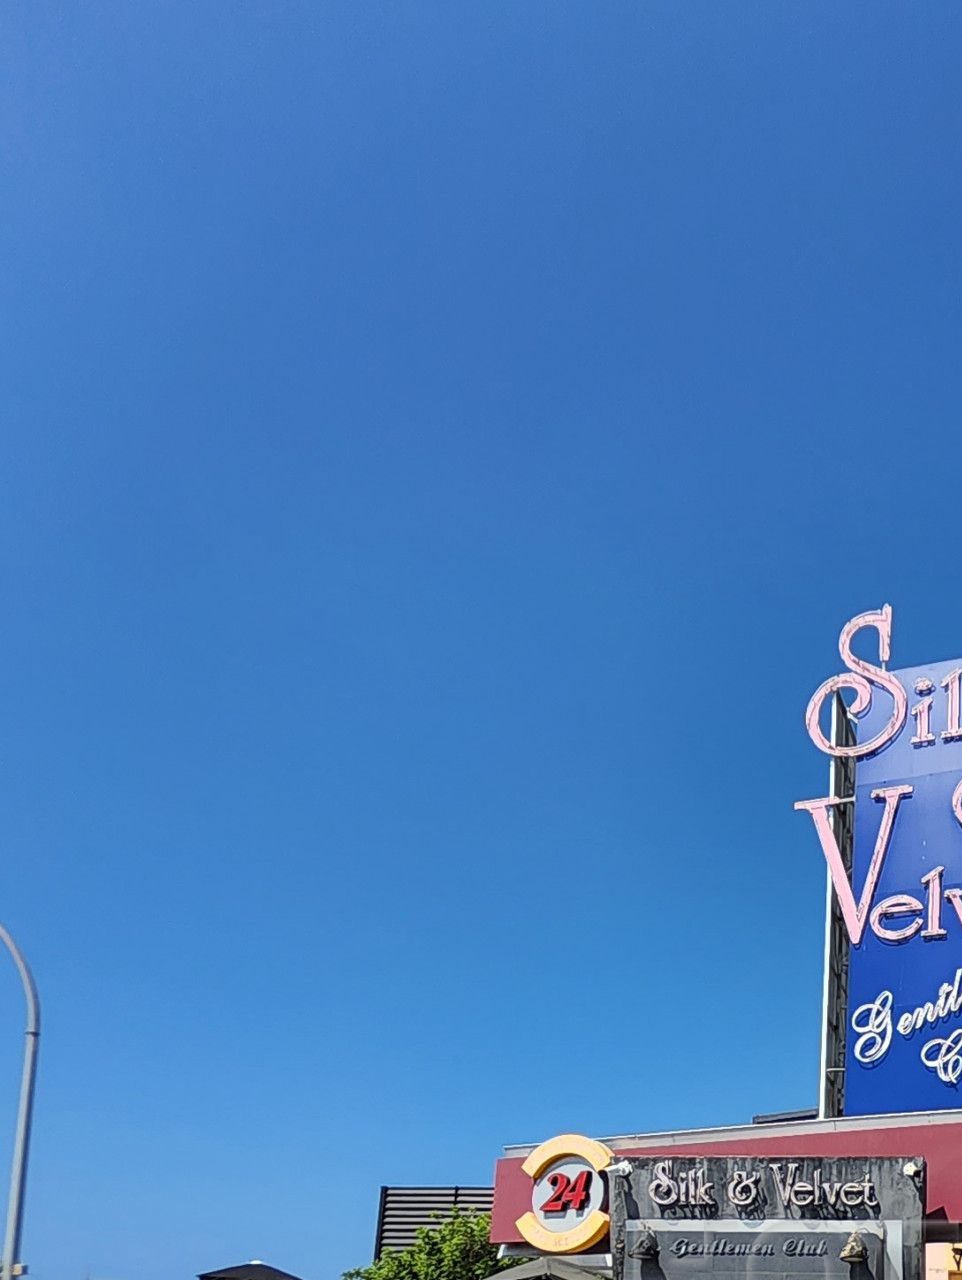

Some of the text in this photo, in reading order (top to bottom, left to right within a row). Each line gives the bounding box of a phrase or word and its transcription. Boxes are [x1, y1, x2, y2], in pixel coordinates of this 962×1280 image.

[539, 1170, 593, 1213] 24
[649, 1160, 878, 1206] Silk & Velvet
[669, 1237, 829, 1259] Gentlemen Club
